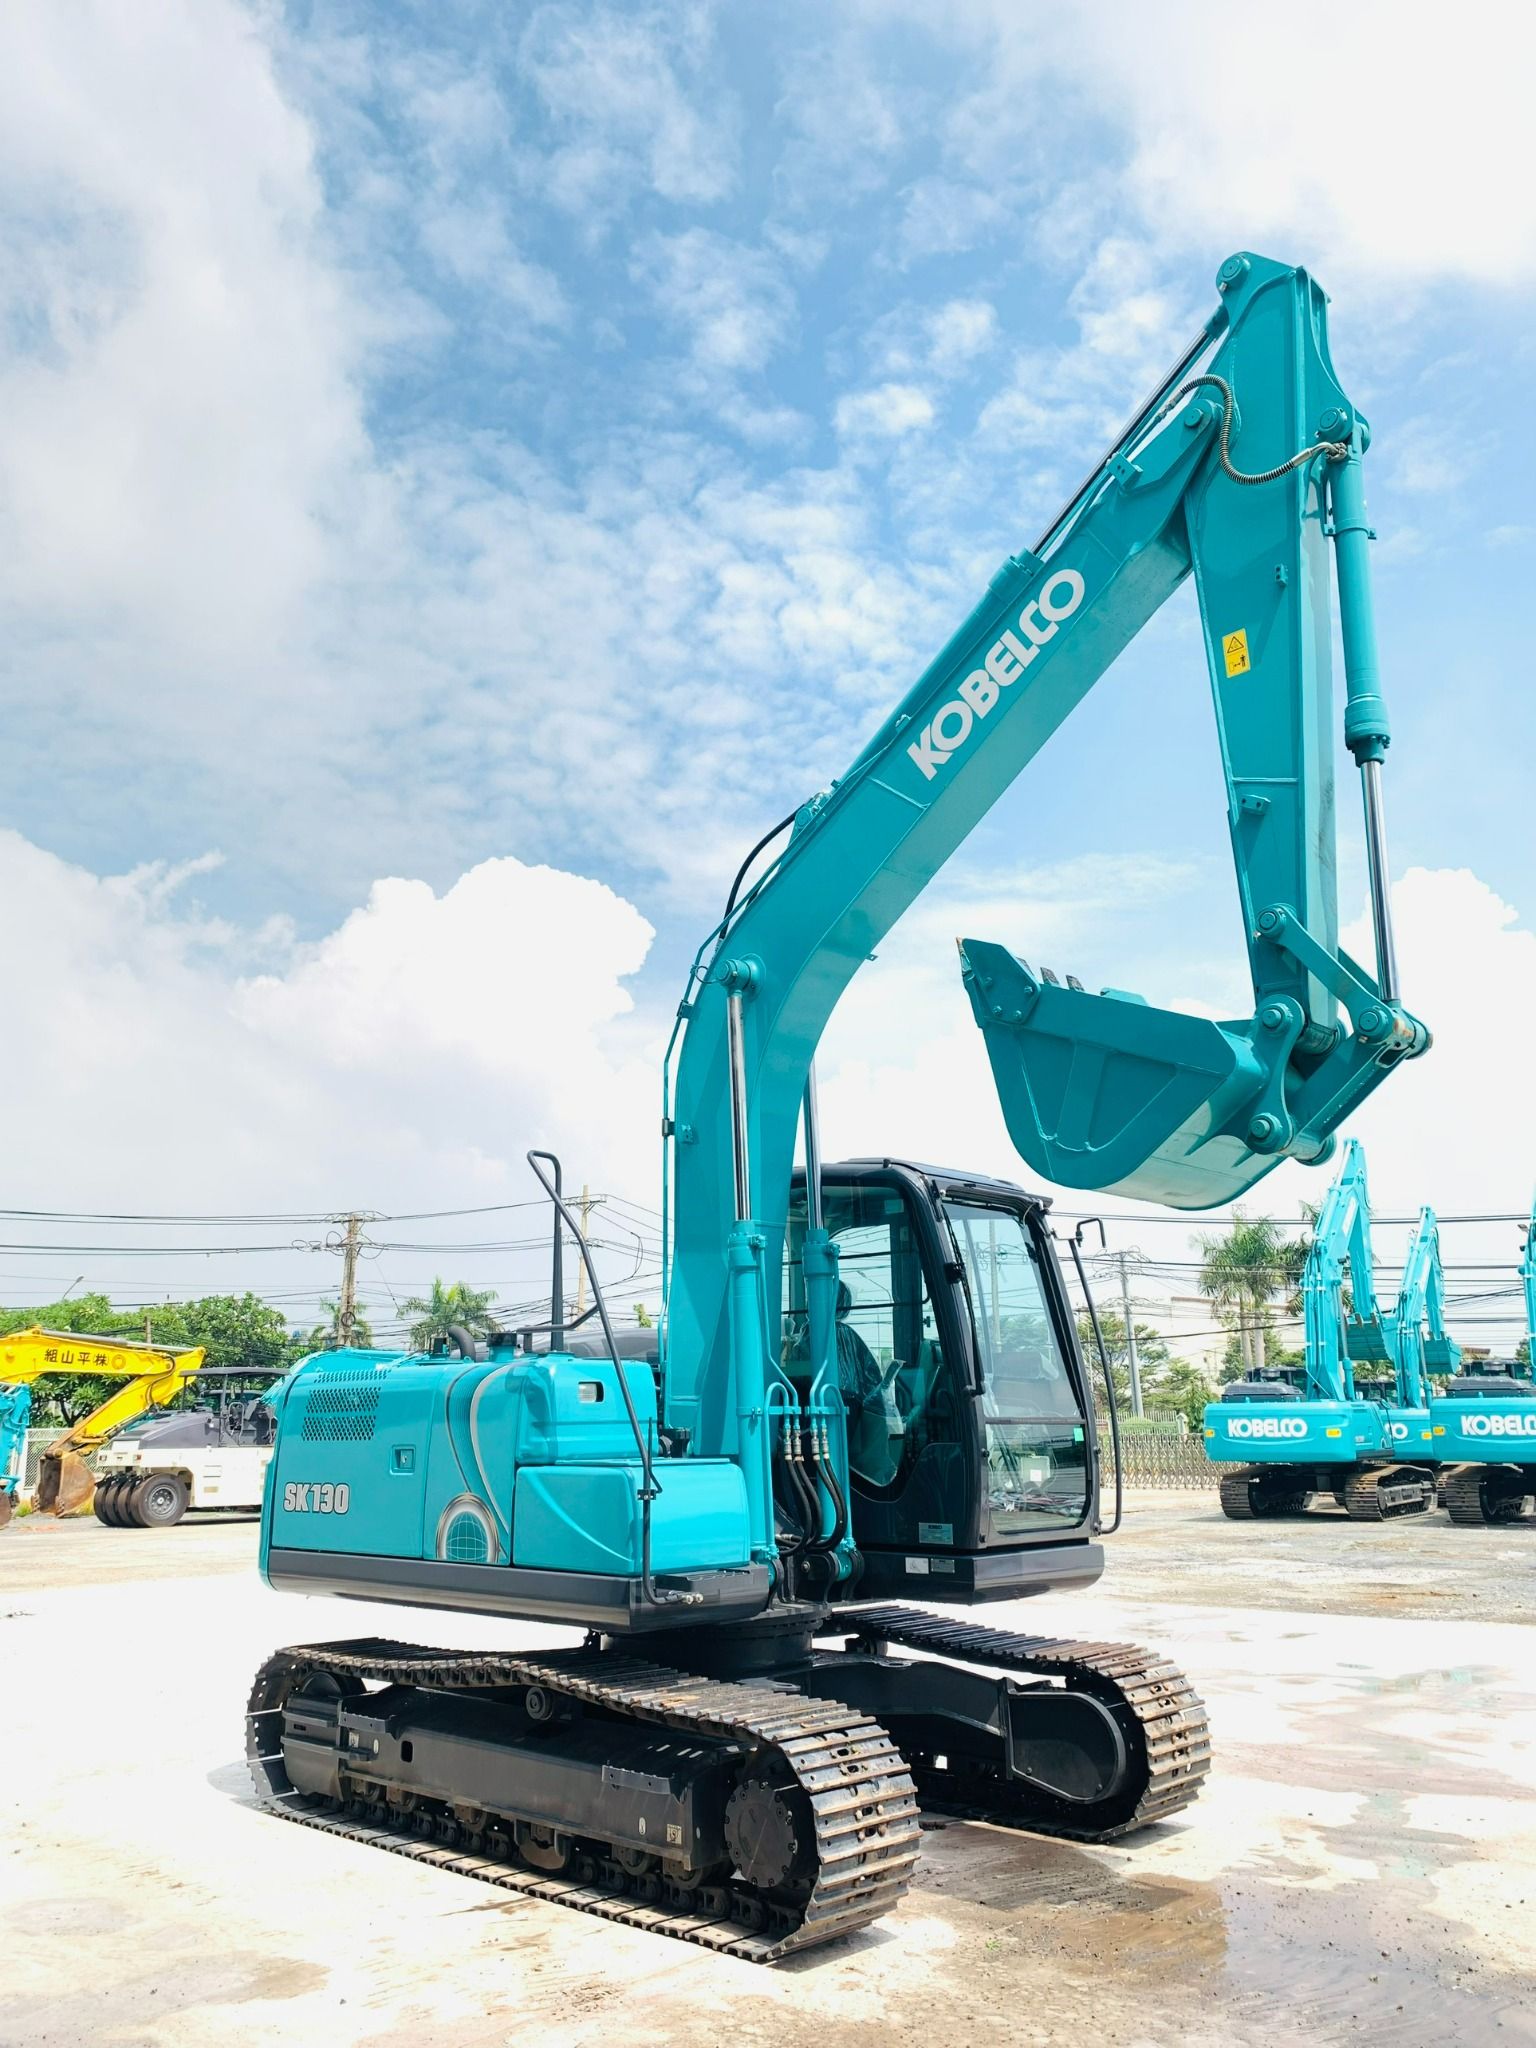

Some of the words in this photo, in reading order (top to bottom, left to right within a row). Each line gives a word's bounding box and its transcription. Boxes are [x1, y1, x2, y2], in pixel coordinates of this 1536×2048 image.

[907, 569, 1085, 781] KOBELCO
[1227, 1418, 1308, 1438] KOBELCO
[1461, 1415, 1536, 1436] KOBELC
[283, 1481, 350, 1515] SK130
